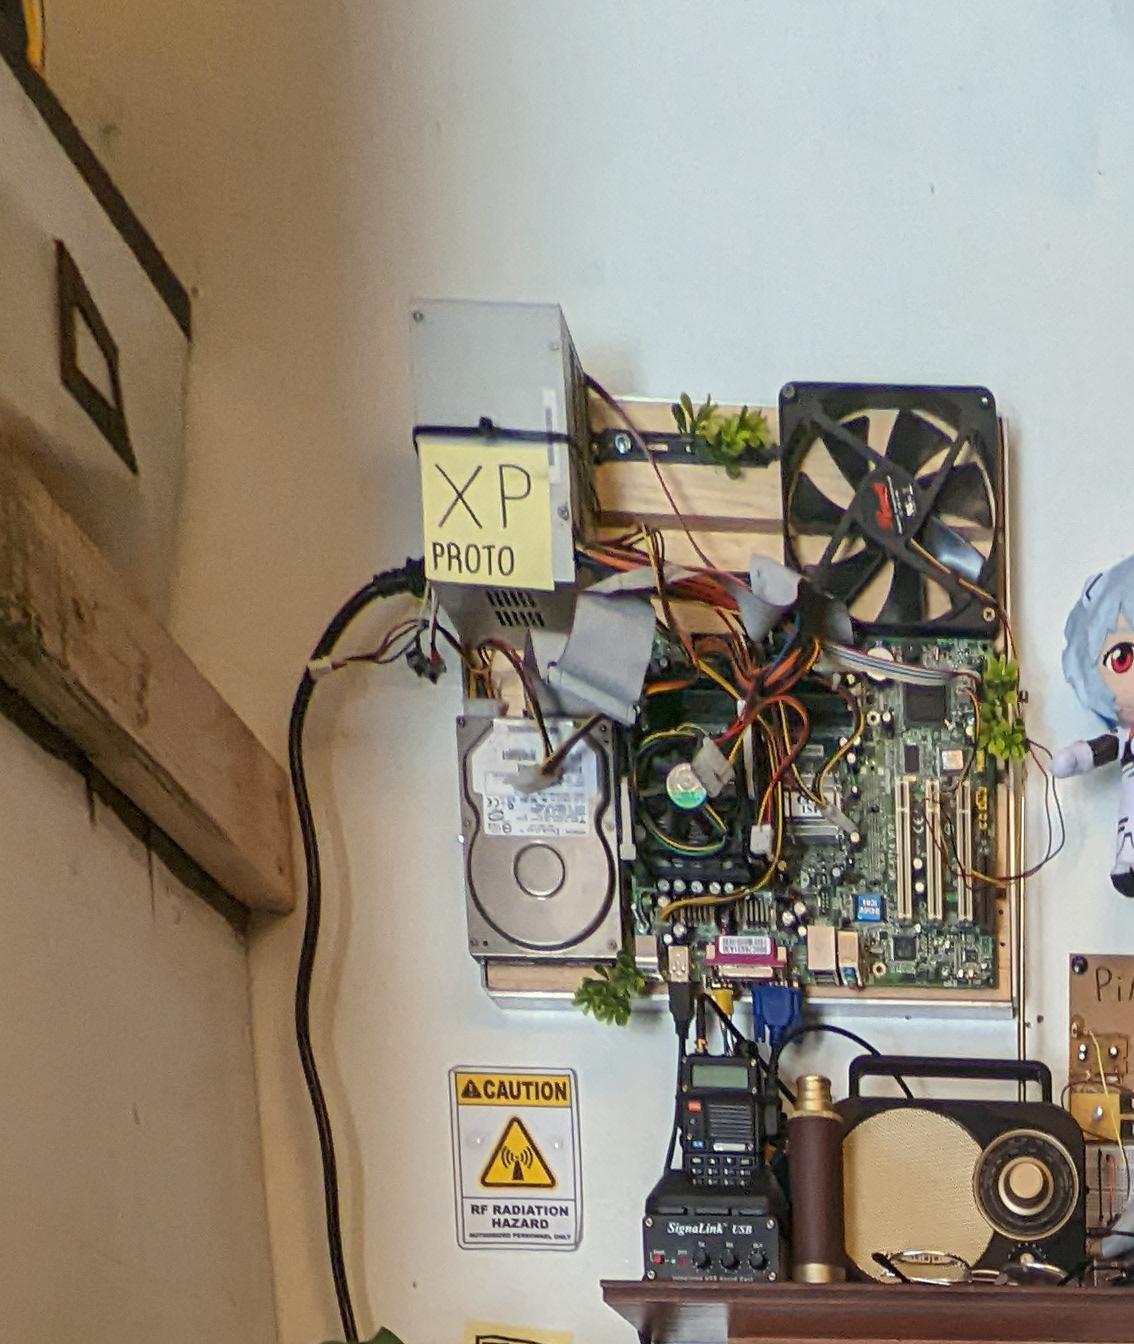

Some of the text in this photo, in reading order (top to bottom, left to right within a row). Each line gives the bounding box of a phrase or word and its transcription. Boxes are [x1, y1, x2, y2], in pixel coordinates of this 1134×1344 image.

[435, 464, 531, 528] XP
[432, 542, 514, 576] PROTO
[483, 1080, 567, 1101] CAUTION
[471, 1204, 569, 1216] RF RADIATION
[492, 1218, 549, 1229] HAZARD
[732, 1224, 752, 1235] USB
